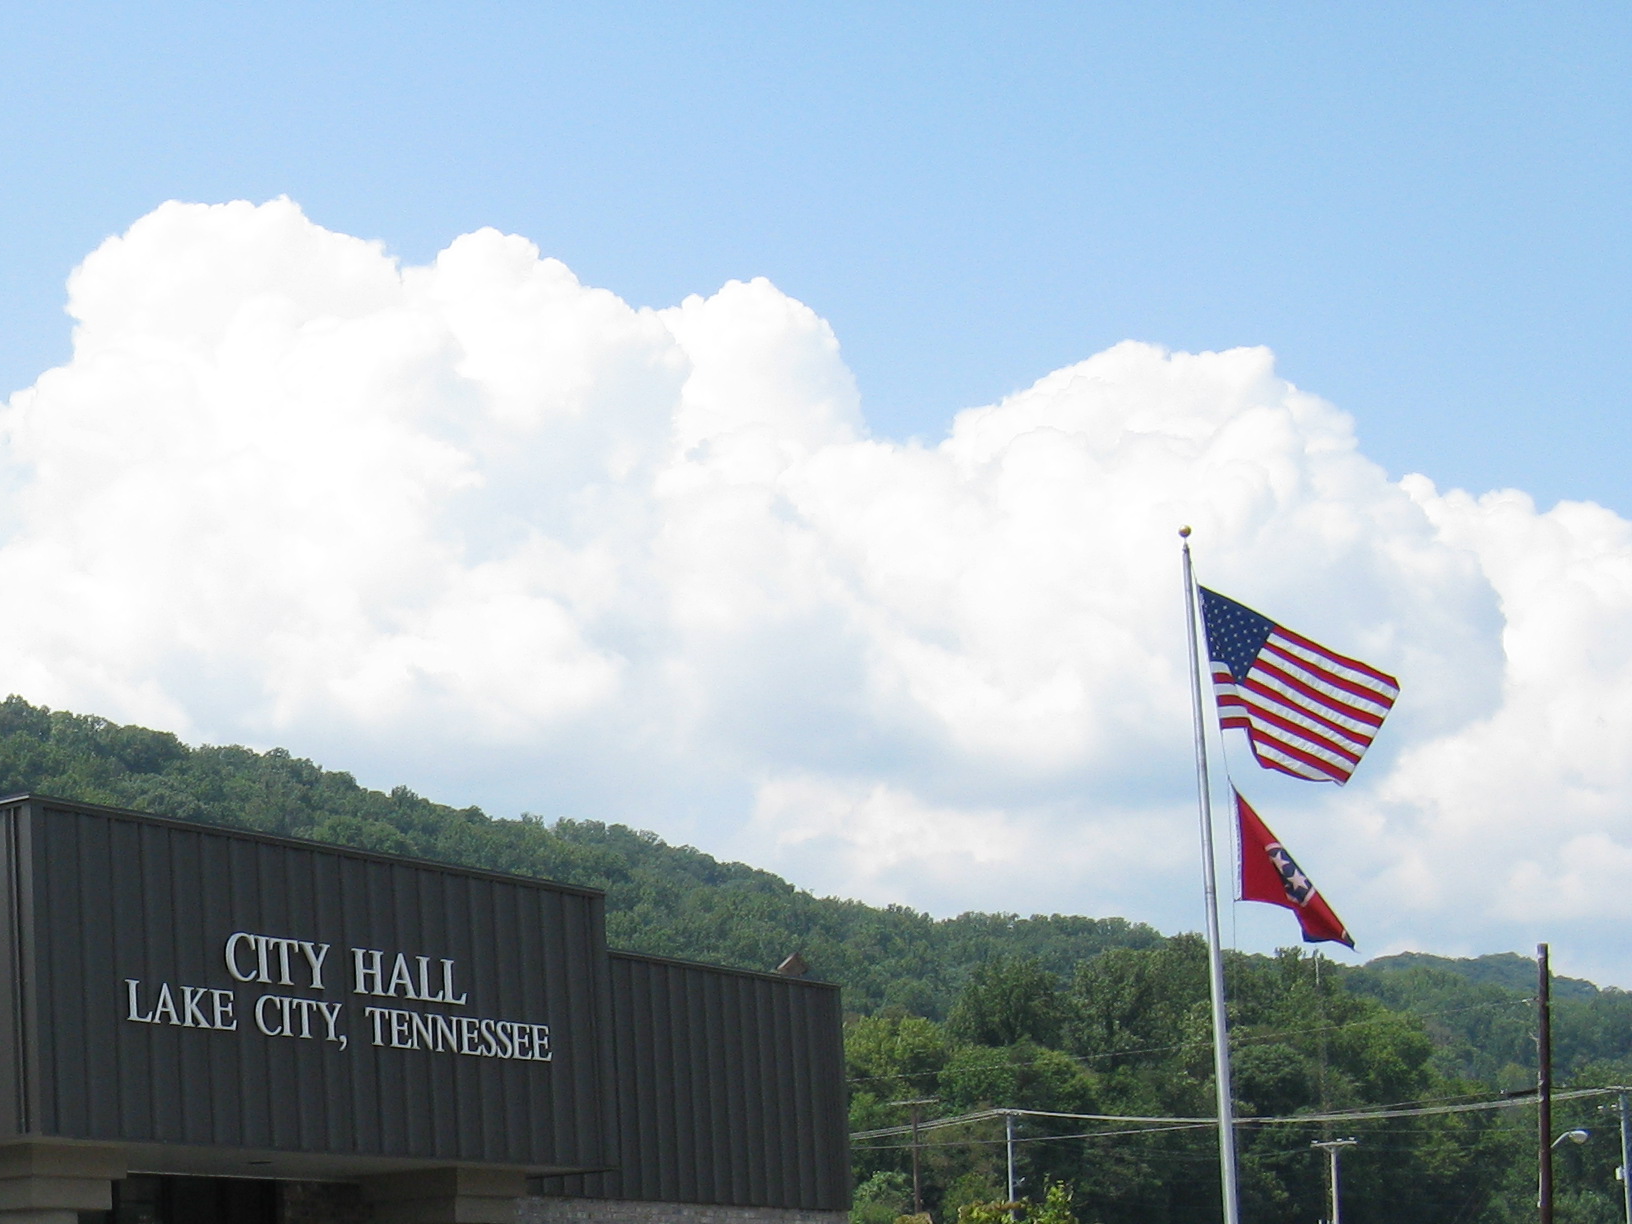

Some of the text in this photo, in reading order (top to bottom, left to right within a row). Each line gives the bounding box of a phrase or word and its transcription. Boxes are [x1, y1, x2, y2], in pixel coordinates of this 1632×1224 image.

[225, 931, 467, 1005] CITY HALL
[124, 979, 553, 1062] LAKE CITY, TENNESSEE
